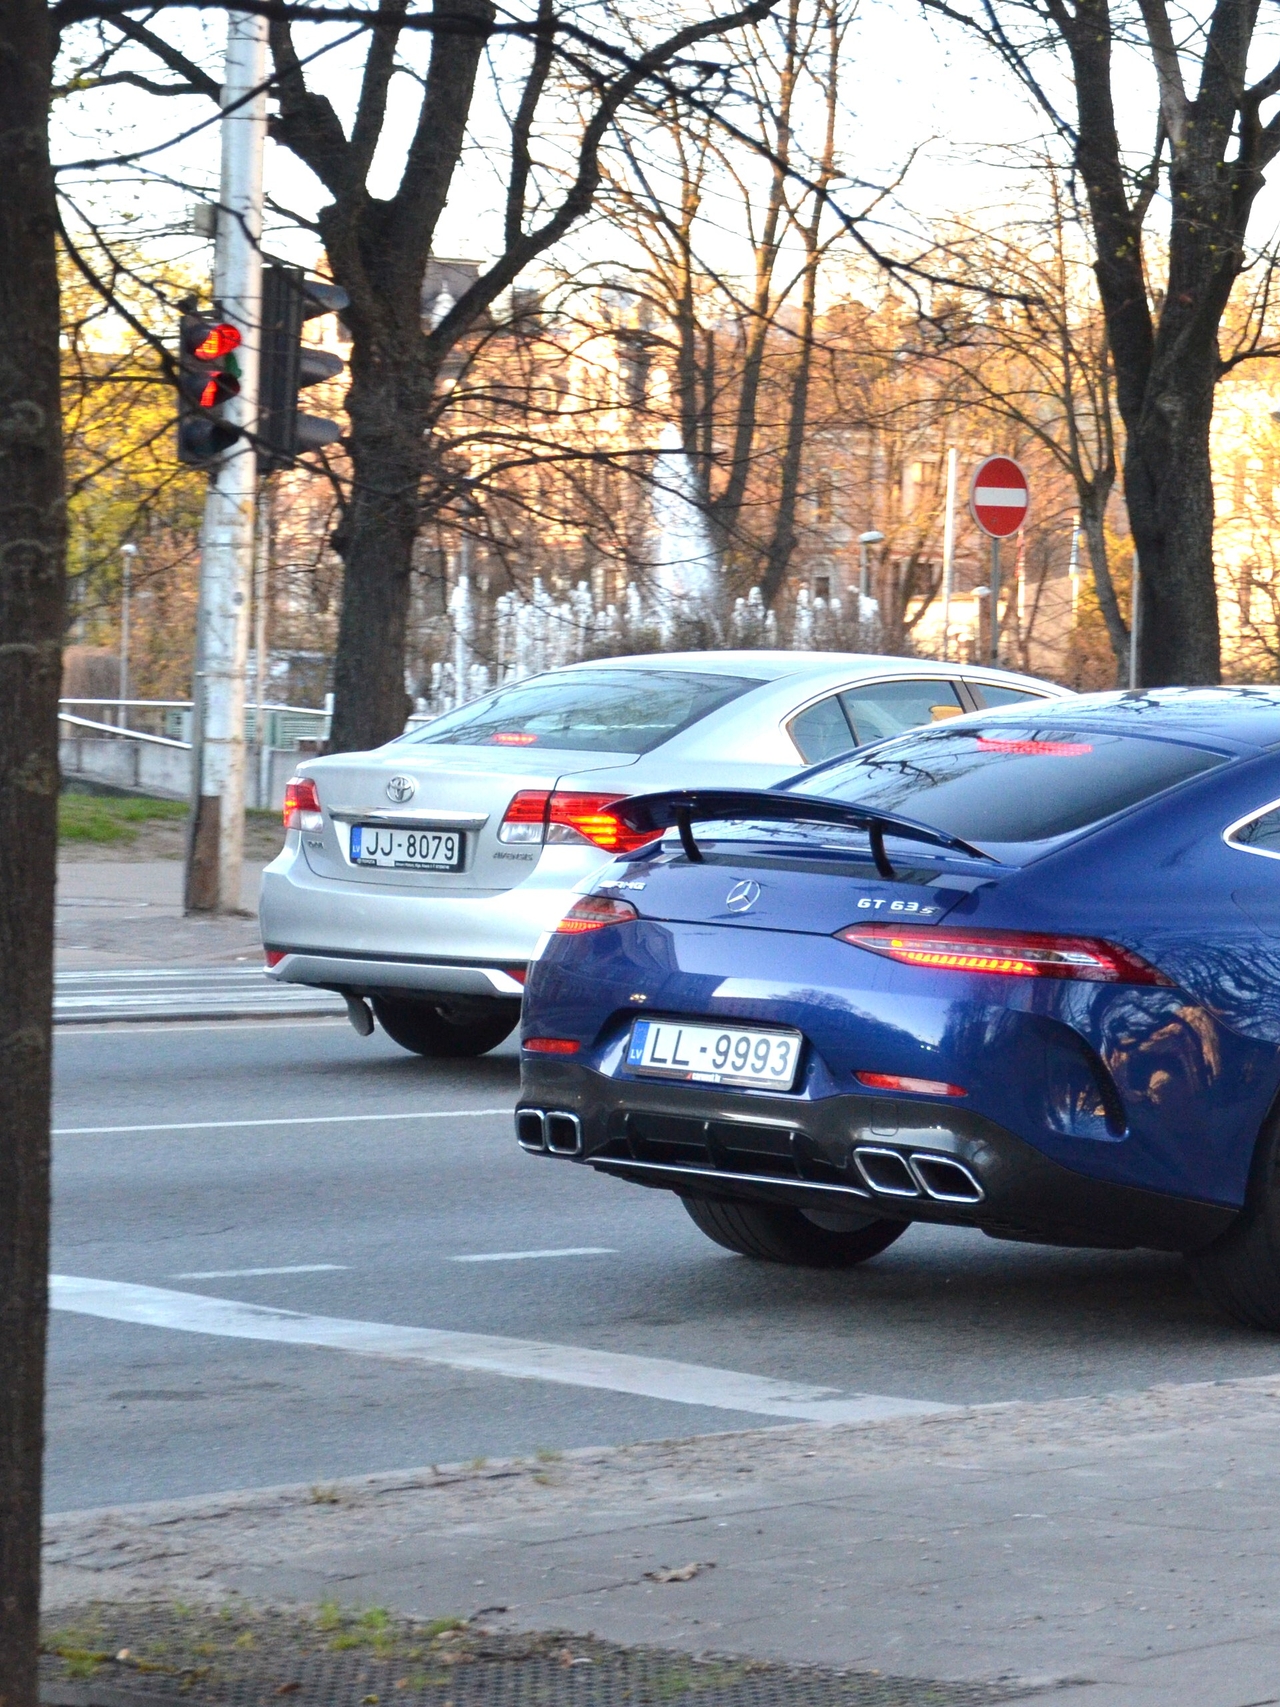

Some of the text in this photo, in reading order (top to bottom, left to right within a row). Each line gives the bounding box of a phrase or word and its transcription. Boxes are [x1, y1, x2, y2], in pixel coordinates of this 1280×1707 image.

[352, 845, 361, 853] LV
[365, 831, 455, 861] JJ-8079
[857, 898, 886, 909] GT
[629, 1049, 643, 1060] LV
[649, 1027, 792, 1077] LL-9993
